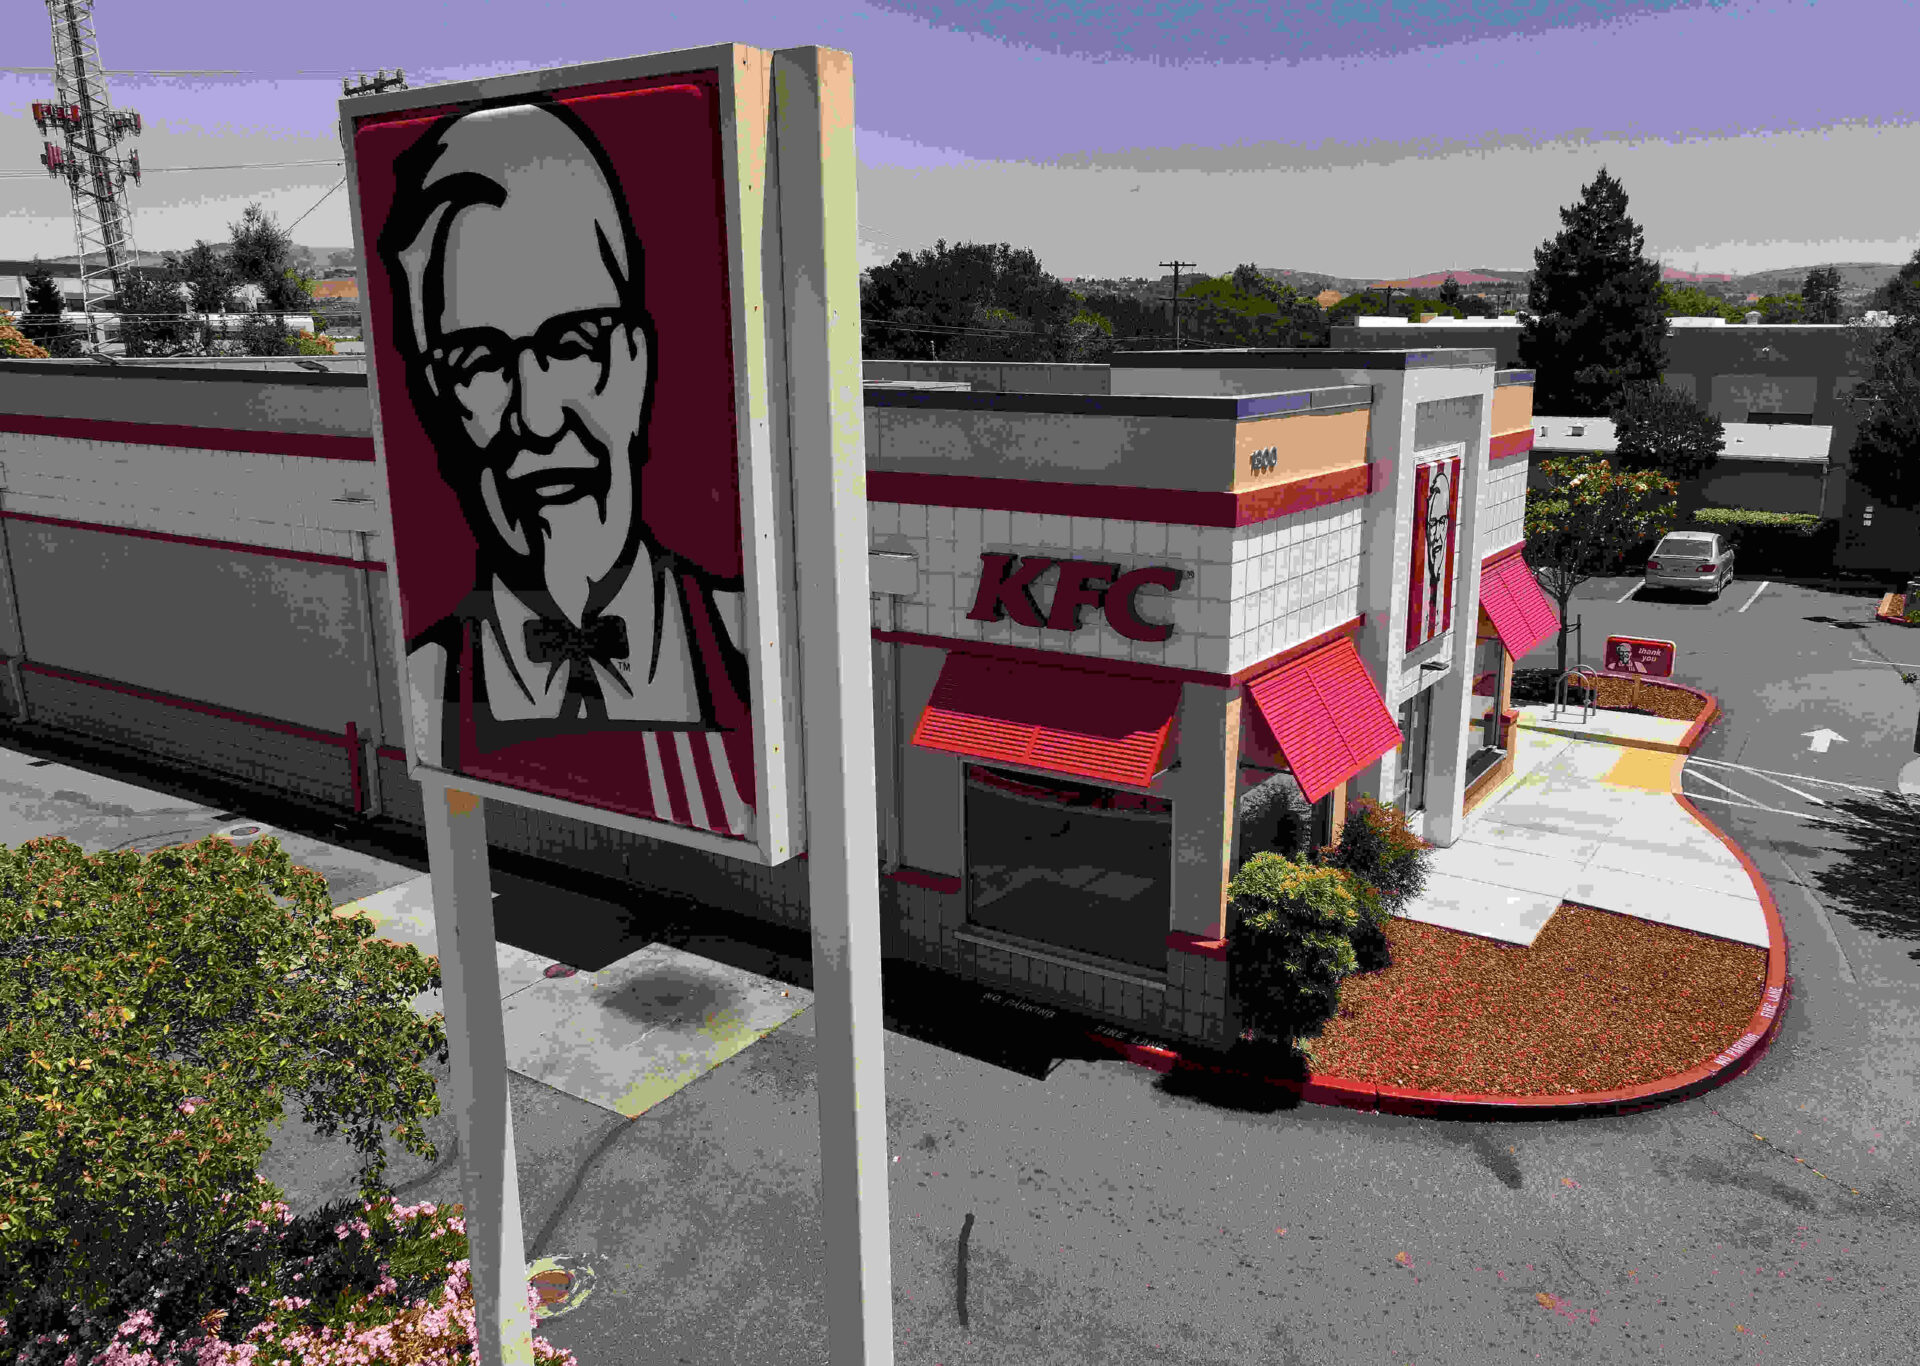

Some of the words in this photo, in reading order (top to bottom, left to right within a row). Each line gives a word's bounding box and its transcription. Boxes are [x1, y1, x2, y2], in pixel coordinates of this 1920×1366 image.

[966, 552, 1183, 642] KFC
[1638, 647, 1661, 656] thank
[618, 661, 631, 672] TM
[1767, 986, 1782, 1002] LANE
[983, 992, 1001, 1002] NO
[1003, 998, 1056, 1018] PARKING
[1095, 1025, 1127, 1039] FIRE
[1761, 1002, 1777, 1018] FIRE
